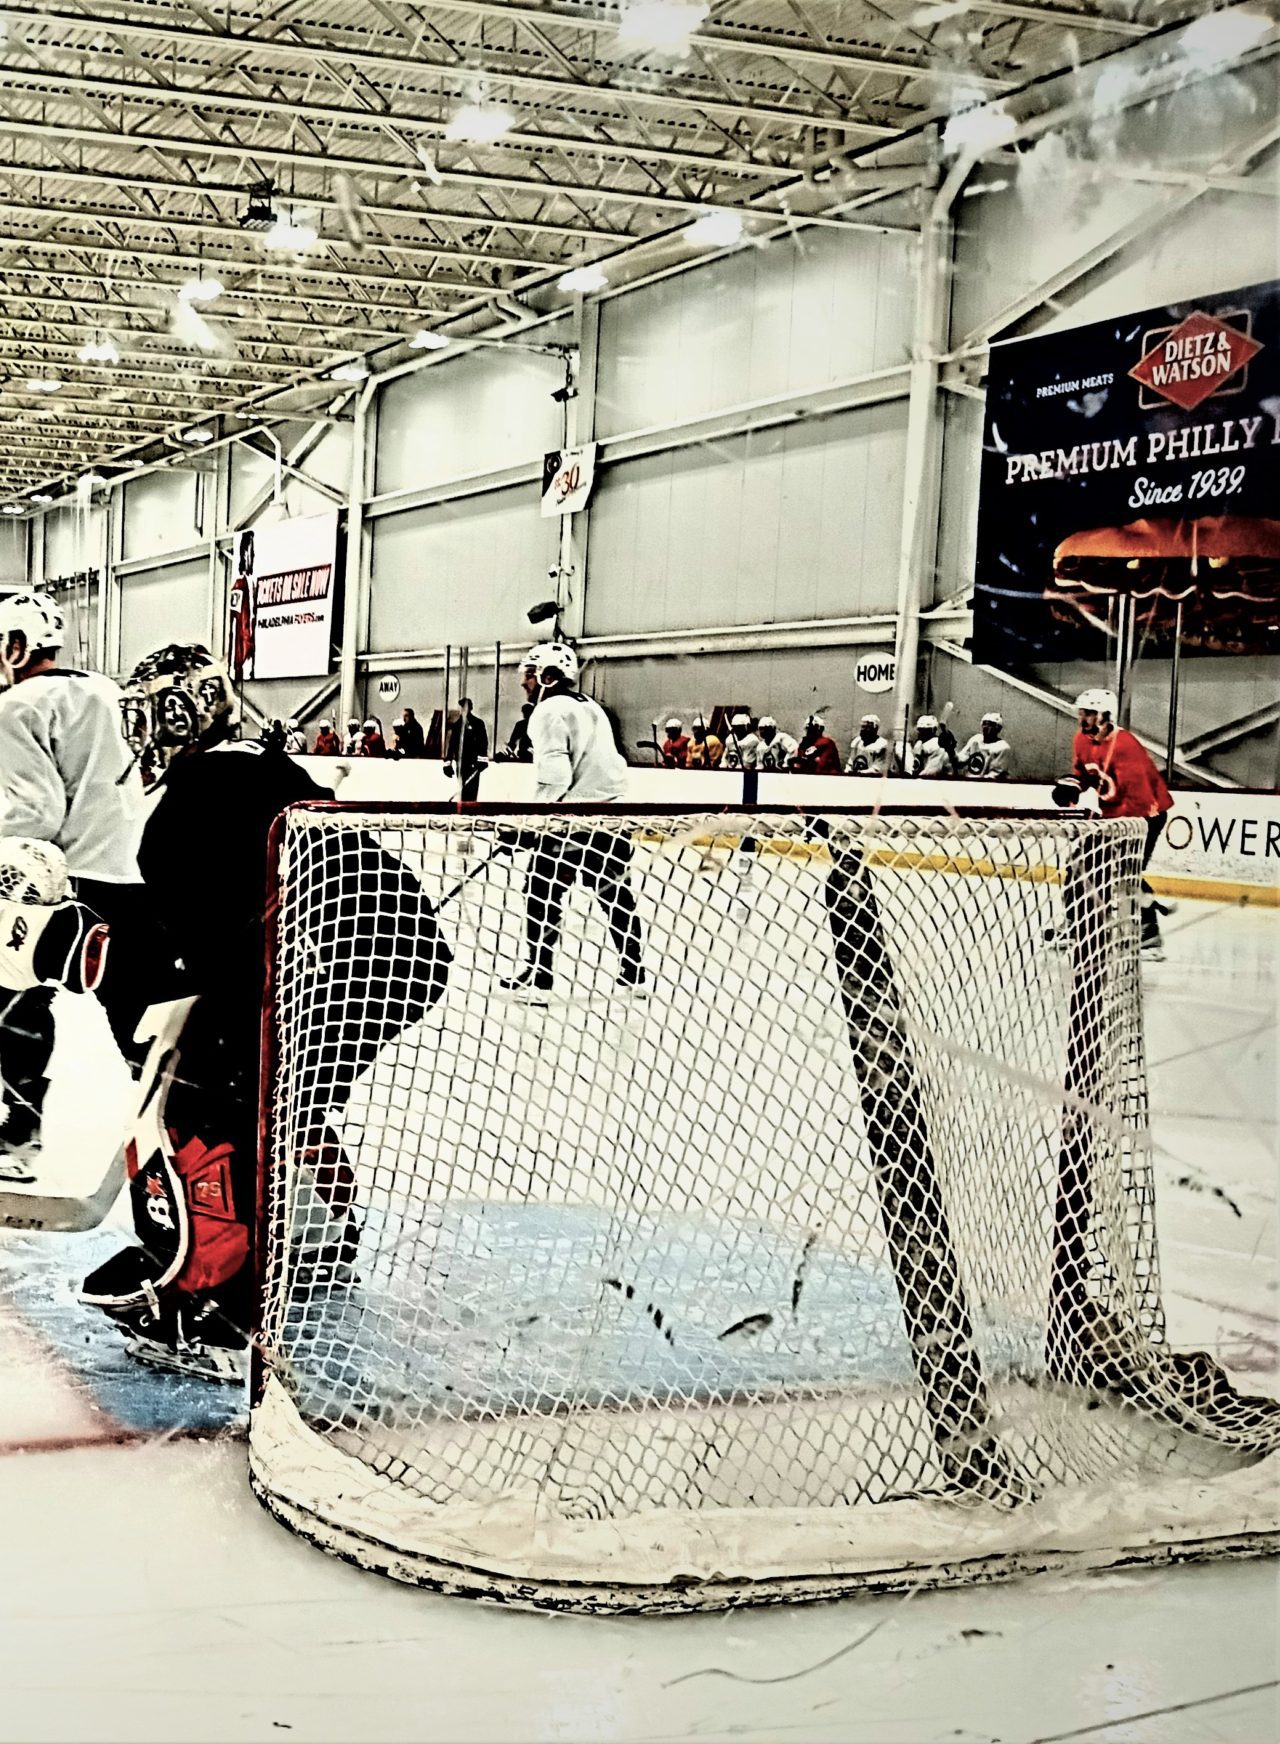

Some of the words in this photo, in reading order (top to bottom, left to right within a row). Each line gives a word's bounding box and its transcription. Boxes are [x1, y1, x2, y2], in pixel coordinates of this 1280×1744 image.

[1165, 333, 1216, 363] DIETZ
[1217, 331, 1232, 351] &
[1152, 352, 1231, 386] WATSON
[1036, 380, 1080, 398] PREMIUM
[1082, 373, 1114, 389] MEATS
[1005, 436, 1138, 485] PREMIUM
[1147, 416, 1262, 463] PHILLY
[1128, 476, 1183, 508] Since
[257, 576, 283, 605] TICKETS
[282, 574, 293, 602] ON
[291, 571, 311, 600] SALE
[309, 567, 330, 597] NOW
[379, 681, 397, 692] AWAY
[856, 663, 895, 682] HOME
